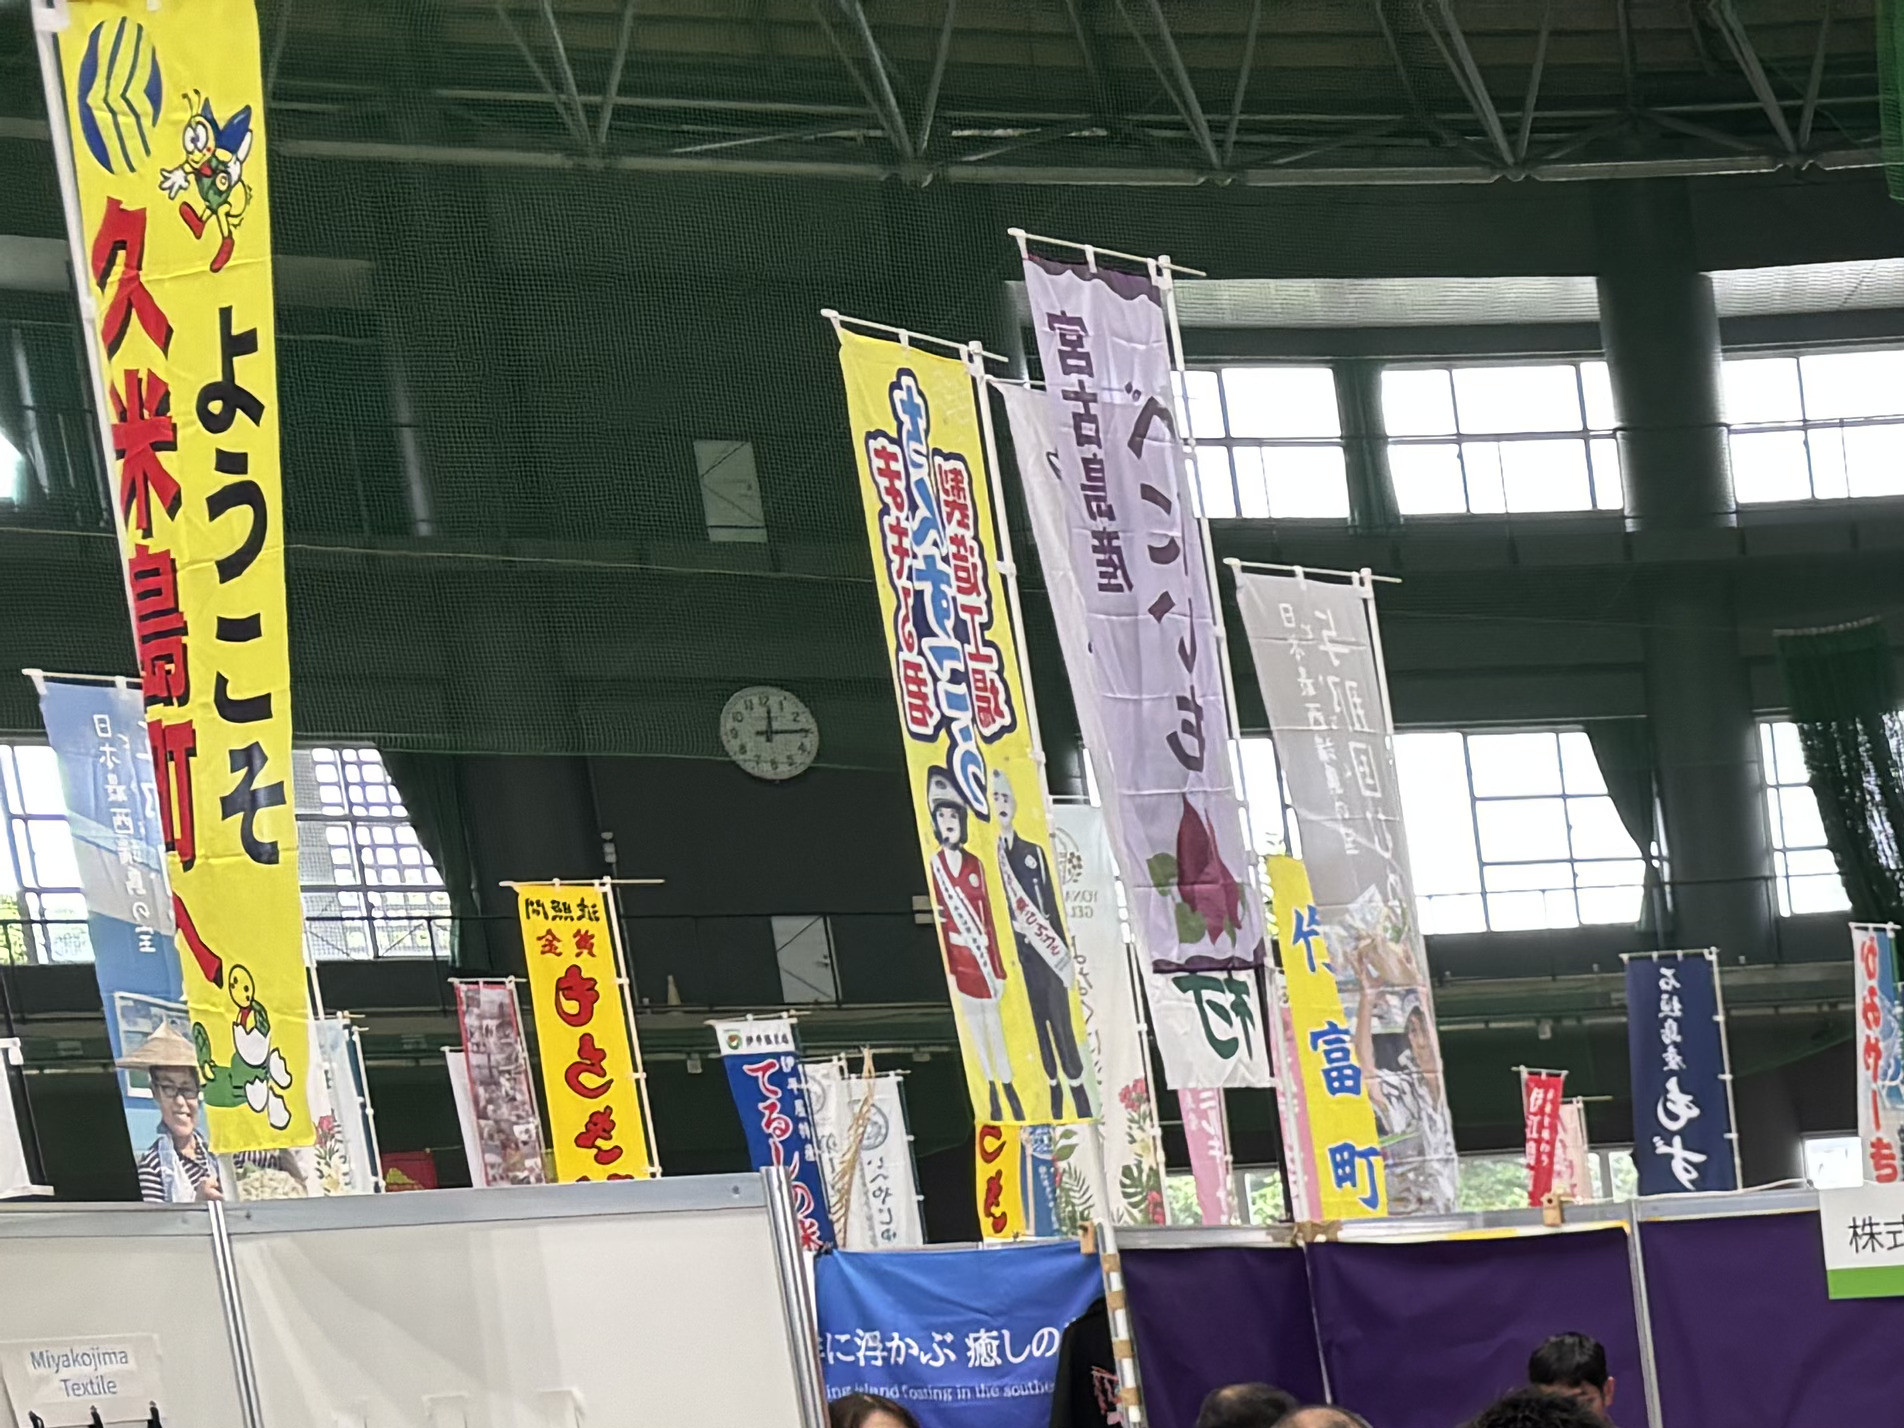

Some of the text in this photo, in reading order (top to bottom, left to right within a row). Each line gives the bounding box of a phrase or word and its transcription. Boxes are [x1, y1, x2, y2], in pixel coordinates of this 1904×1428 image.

[91, 195, 224, 988] 久米島町へ
[196, 304, 286, 868] ようこそ
[30, 1346, 129, 1374] Miyakojima
[60, 1374, 118, 1398] Textile
